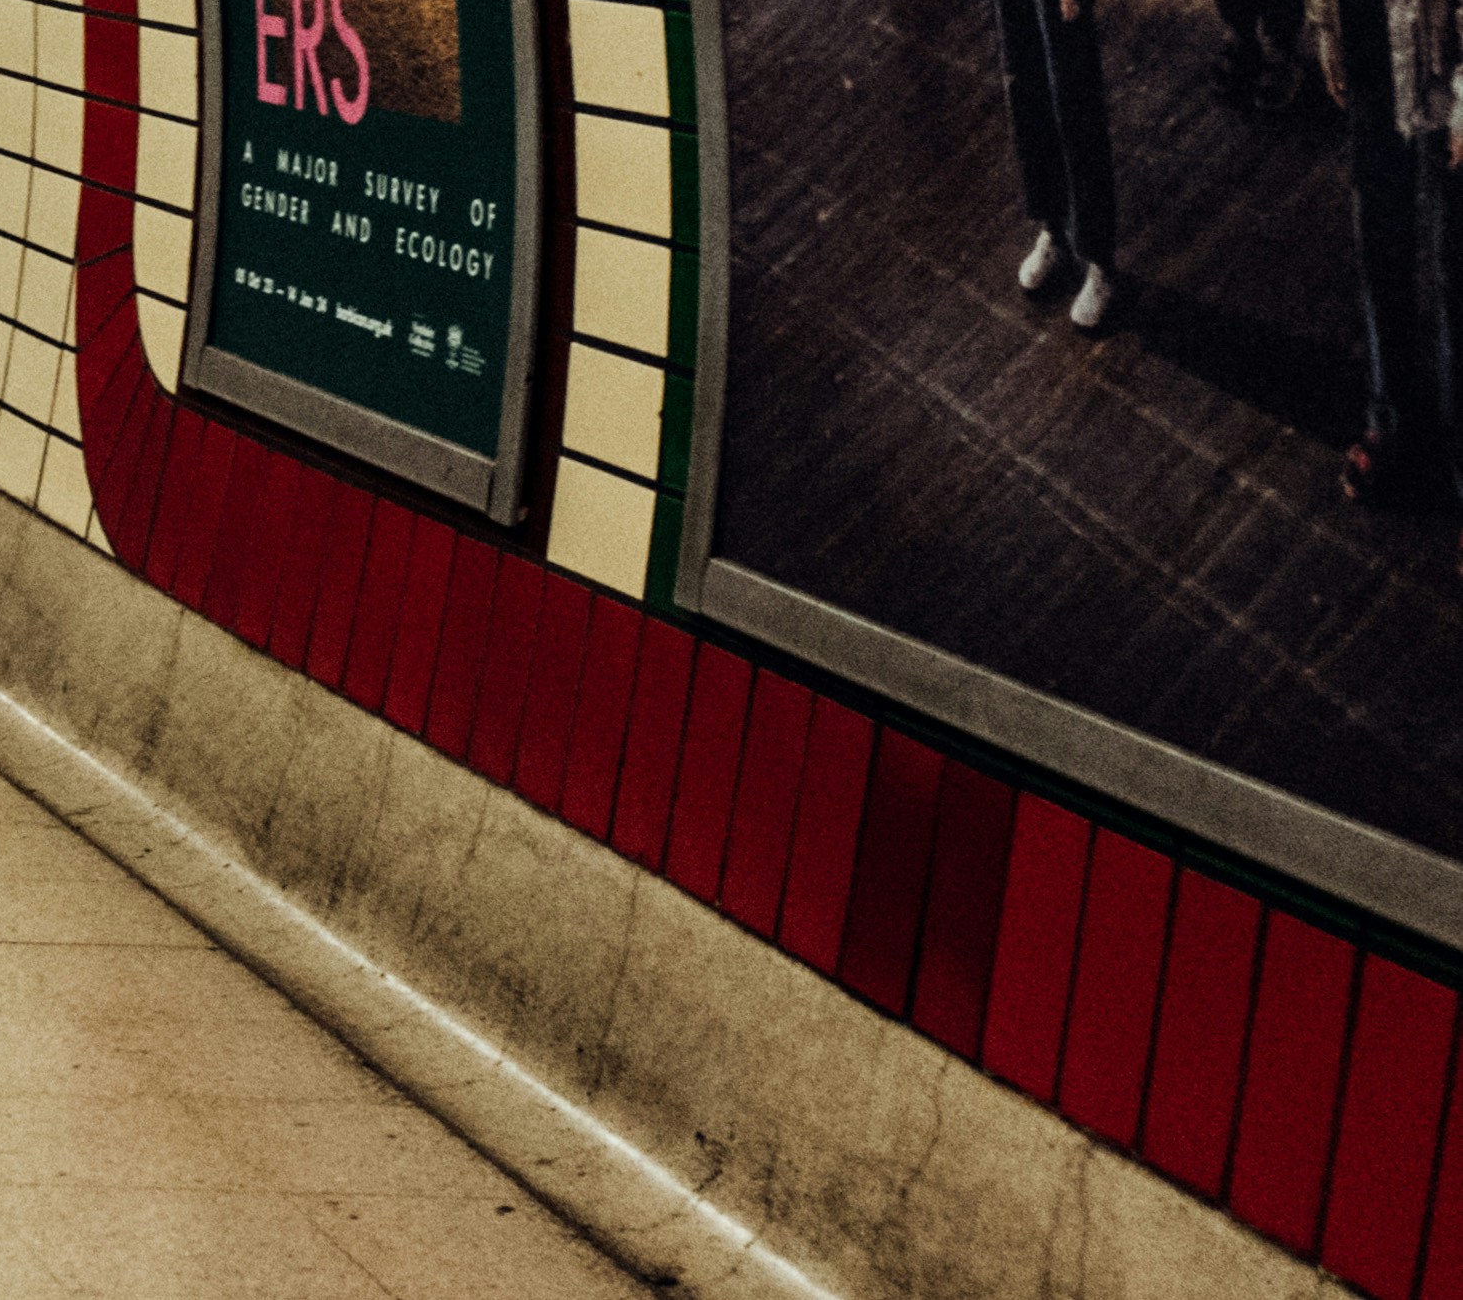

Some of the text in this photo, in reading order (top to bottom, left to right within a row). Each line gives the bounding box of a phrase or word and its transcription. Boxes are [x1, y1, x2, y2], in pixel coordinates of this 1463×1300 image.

[240, 182, 495, 281] GENDER AND ECOLOGY
[242, 139, 497, 231] A MAJOR SURVEY OF
